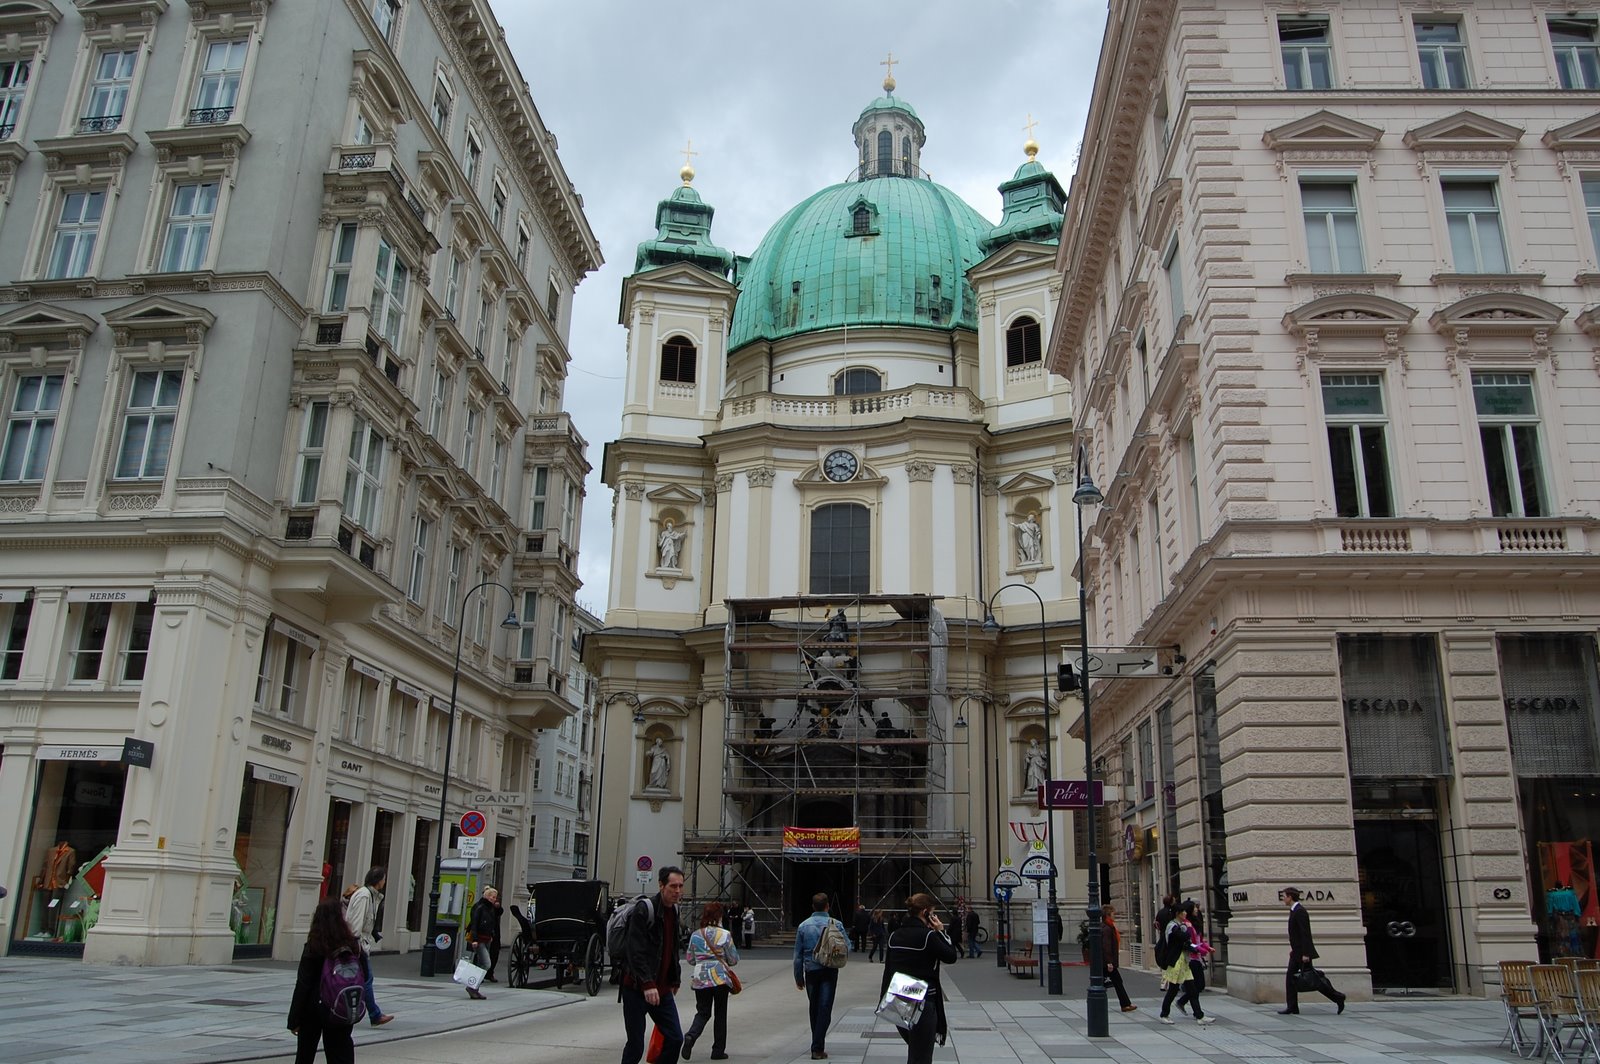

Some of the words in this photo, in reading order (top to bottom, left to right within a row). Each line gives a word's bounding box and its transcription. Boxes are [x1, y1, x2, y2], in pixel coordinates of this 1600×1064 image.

[1348, 698, 1424, 713] ESCADA
[1507, 697, 1580, 711] ESCADA
[341, 760, 363, 774] GANT
[424, 784, 440, 795] GANT
[474, 794, 520, 804] GANT
[1278, 890, 1335, 902] ECADA
